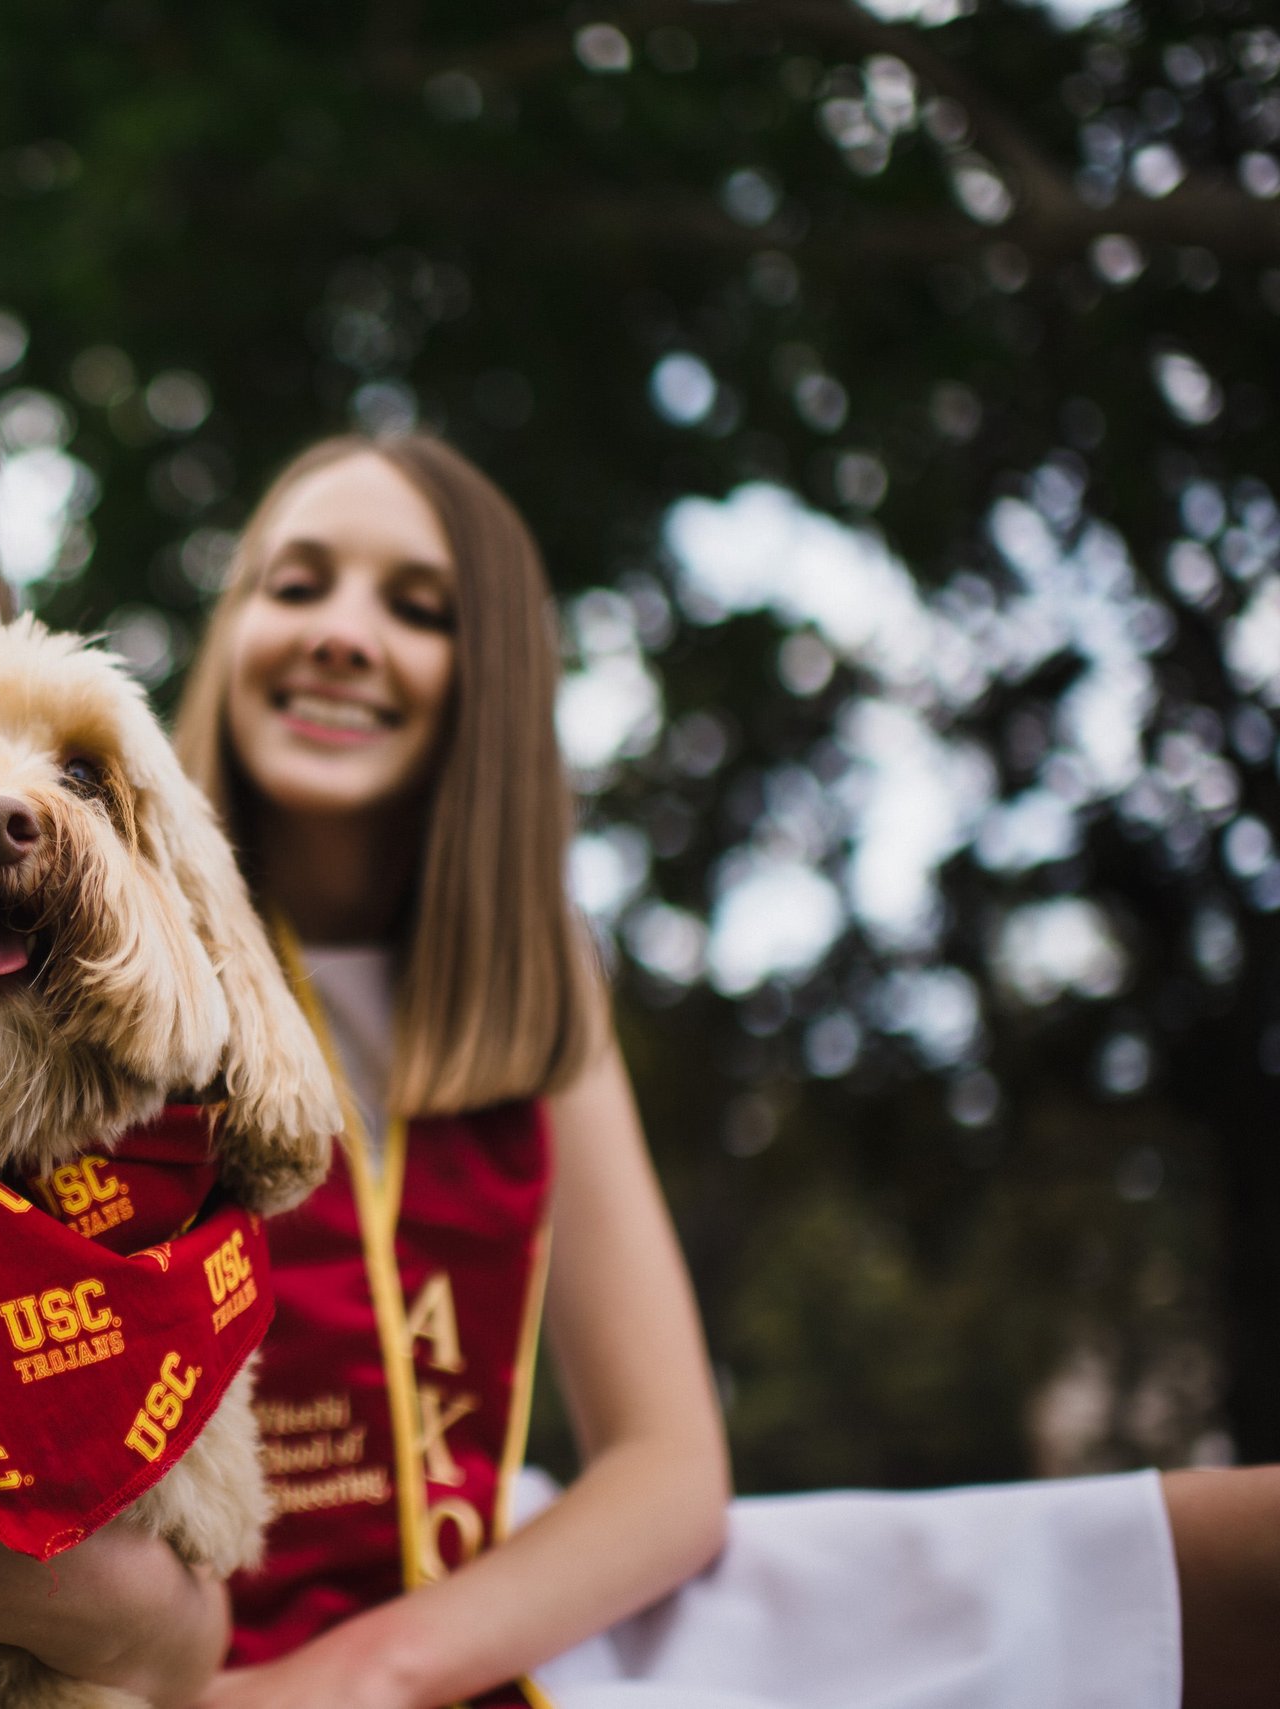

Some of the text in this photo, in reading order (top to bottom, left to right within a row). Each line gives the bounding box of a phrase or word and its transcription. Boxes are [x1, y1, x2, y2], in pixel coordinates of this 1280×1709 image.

[204, 1230, 253, 1306] USC
[13, 1331, 125, 1384] TROJANS
[125, 1351, 198, 1463] USC
